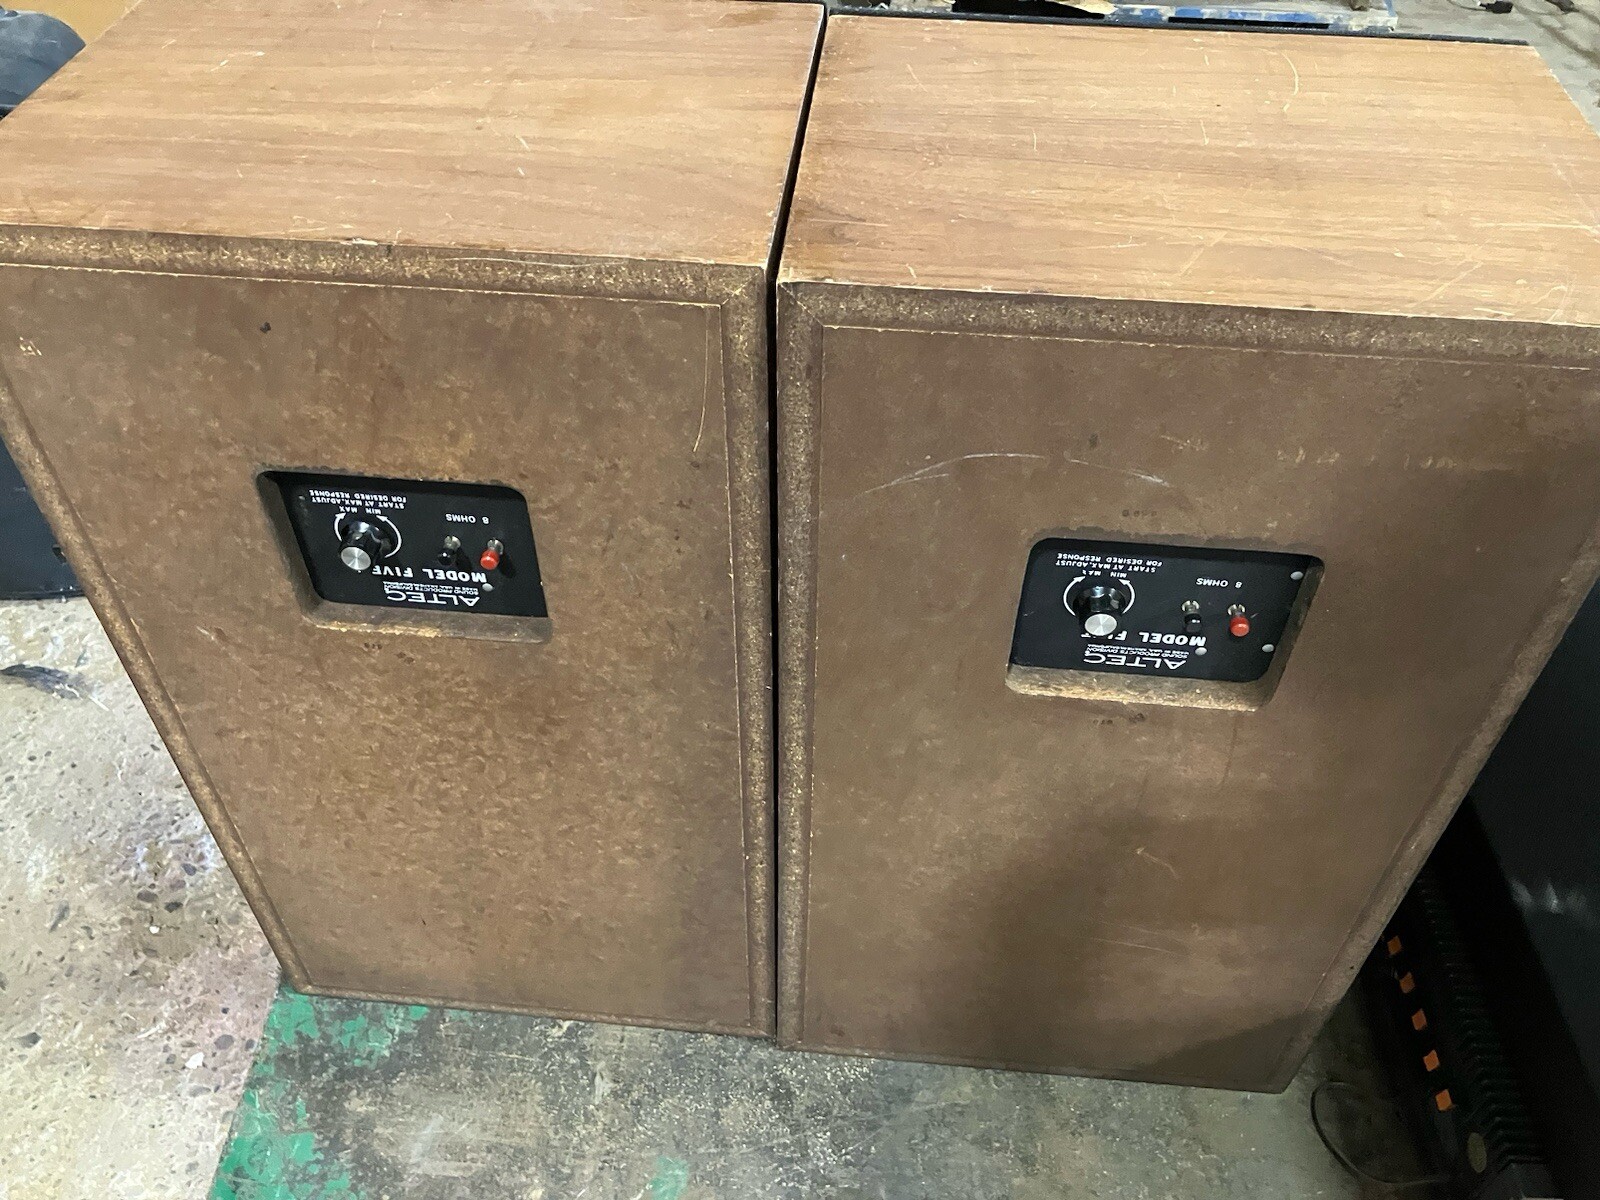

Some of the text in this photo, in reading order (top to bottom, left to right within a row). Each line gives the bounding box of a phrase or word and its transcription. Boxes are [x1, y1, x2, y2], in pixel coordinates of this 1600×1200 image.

[309, 490, 350, 498] RESPONSE
[354, 493, 388, 502] DESIRED
[339, 506, 358, 514] MAX
[446, 514, 489, 524] 8 OHMS
[1057, 552, 1101, 562] RESPONSE
[1106, 556, 1143, 565] DESIRED
[422, 568, 487, 583] MODEL
[1196, 578, 1228, 588] OHMS
[387, 590, 480, 607] ALTEC
[1138, 632, 1206, 646] MODEL
[1084, 653, 1187, 670] ALTEC
